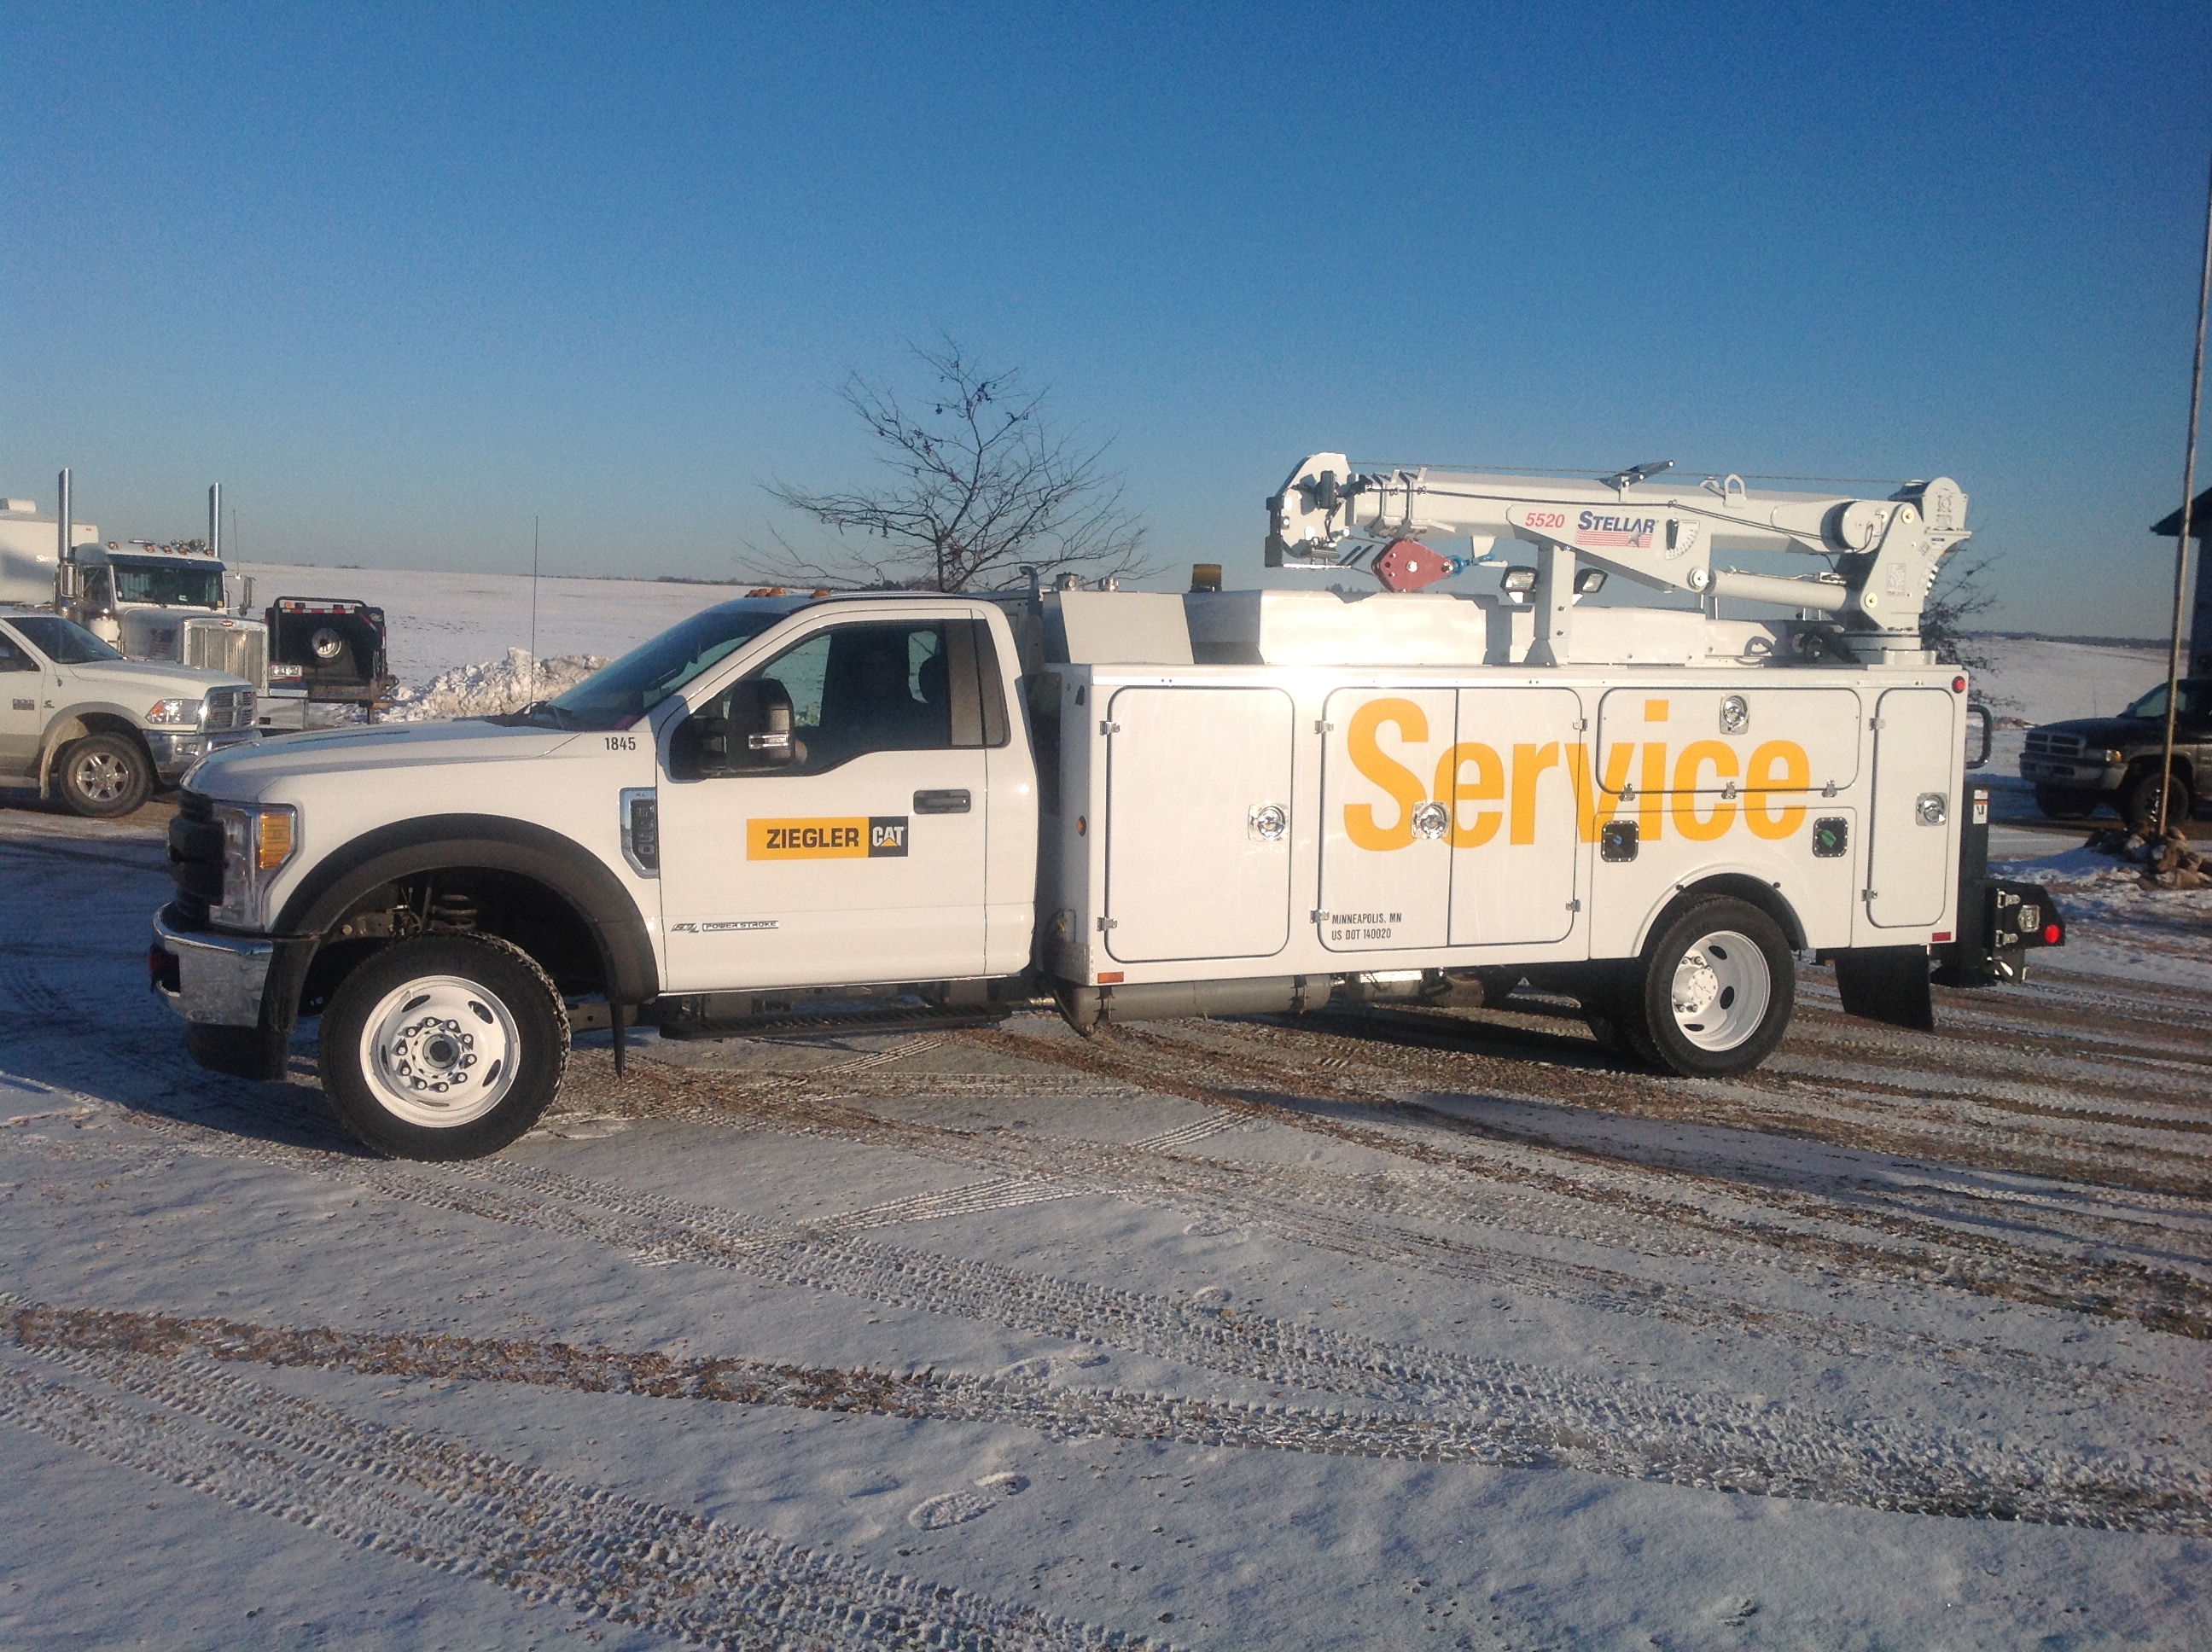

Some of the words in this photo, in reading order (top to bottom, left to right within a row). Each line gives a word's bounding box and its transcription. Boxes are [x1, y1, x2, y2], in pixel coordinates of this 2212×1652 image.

[1525, 512, 1565, 528] 5520
[1578, 510, 1656, 533] STELLAR
[604, 736, 637, 751] 1845
[1343, 697, 1811, 852] Service
[766, 827, 859, 849] ZIEGLER
[872, 826, 905, 847] CAT
[1331, 913, 1387, 924] MINNEAPOLIS,
[1389, 912, 1402, 922] MN
[1331, 929, 1342, 940] US
[1345, 928, 1361, 939] DOT
[1363, 928, 1392, 939] 140020
